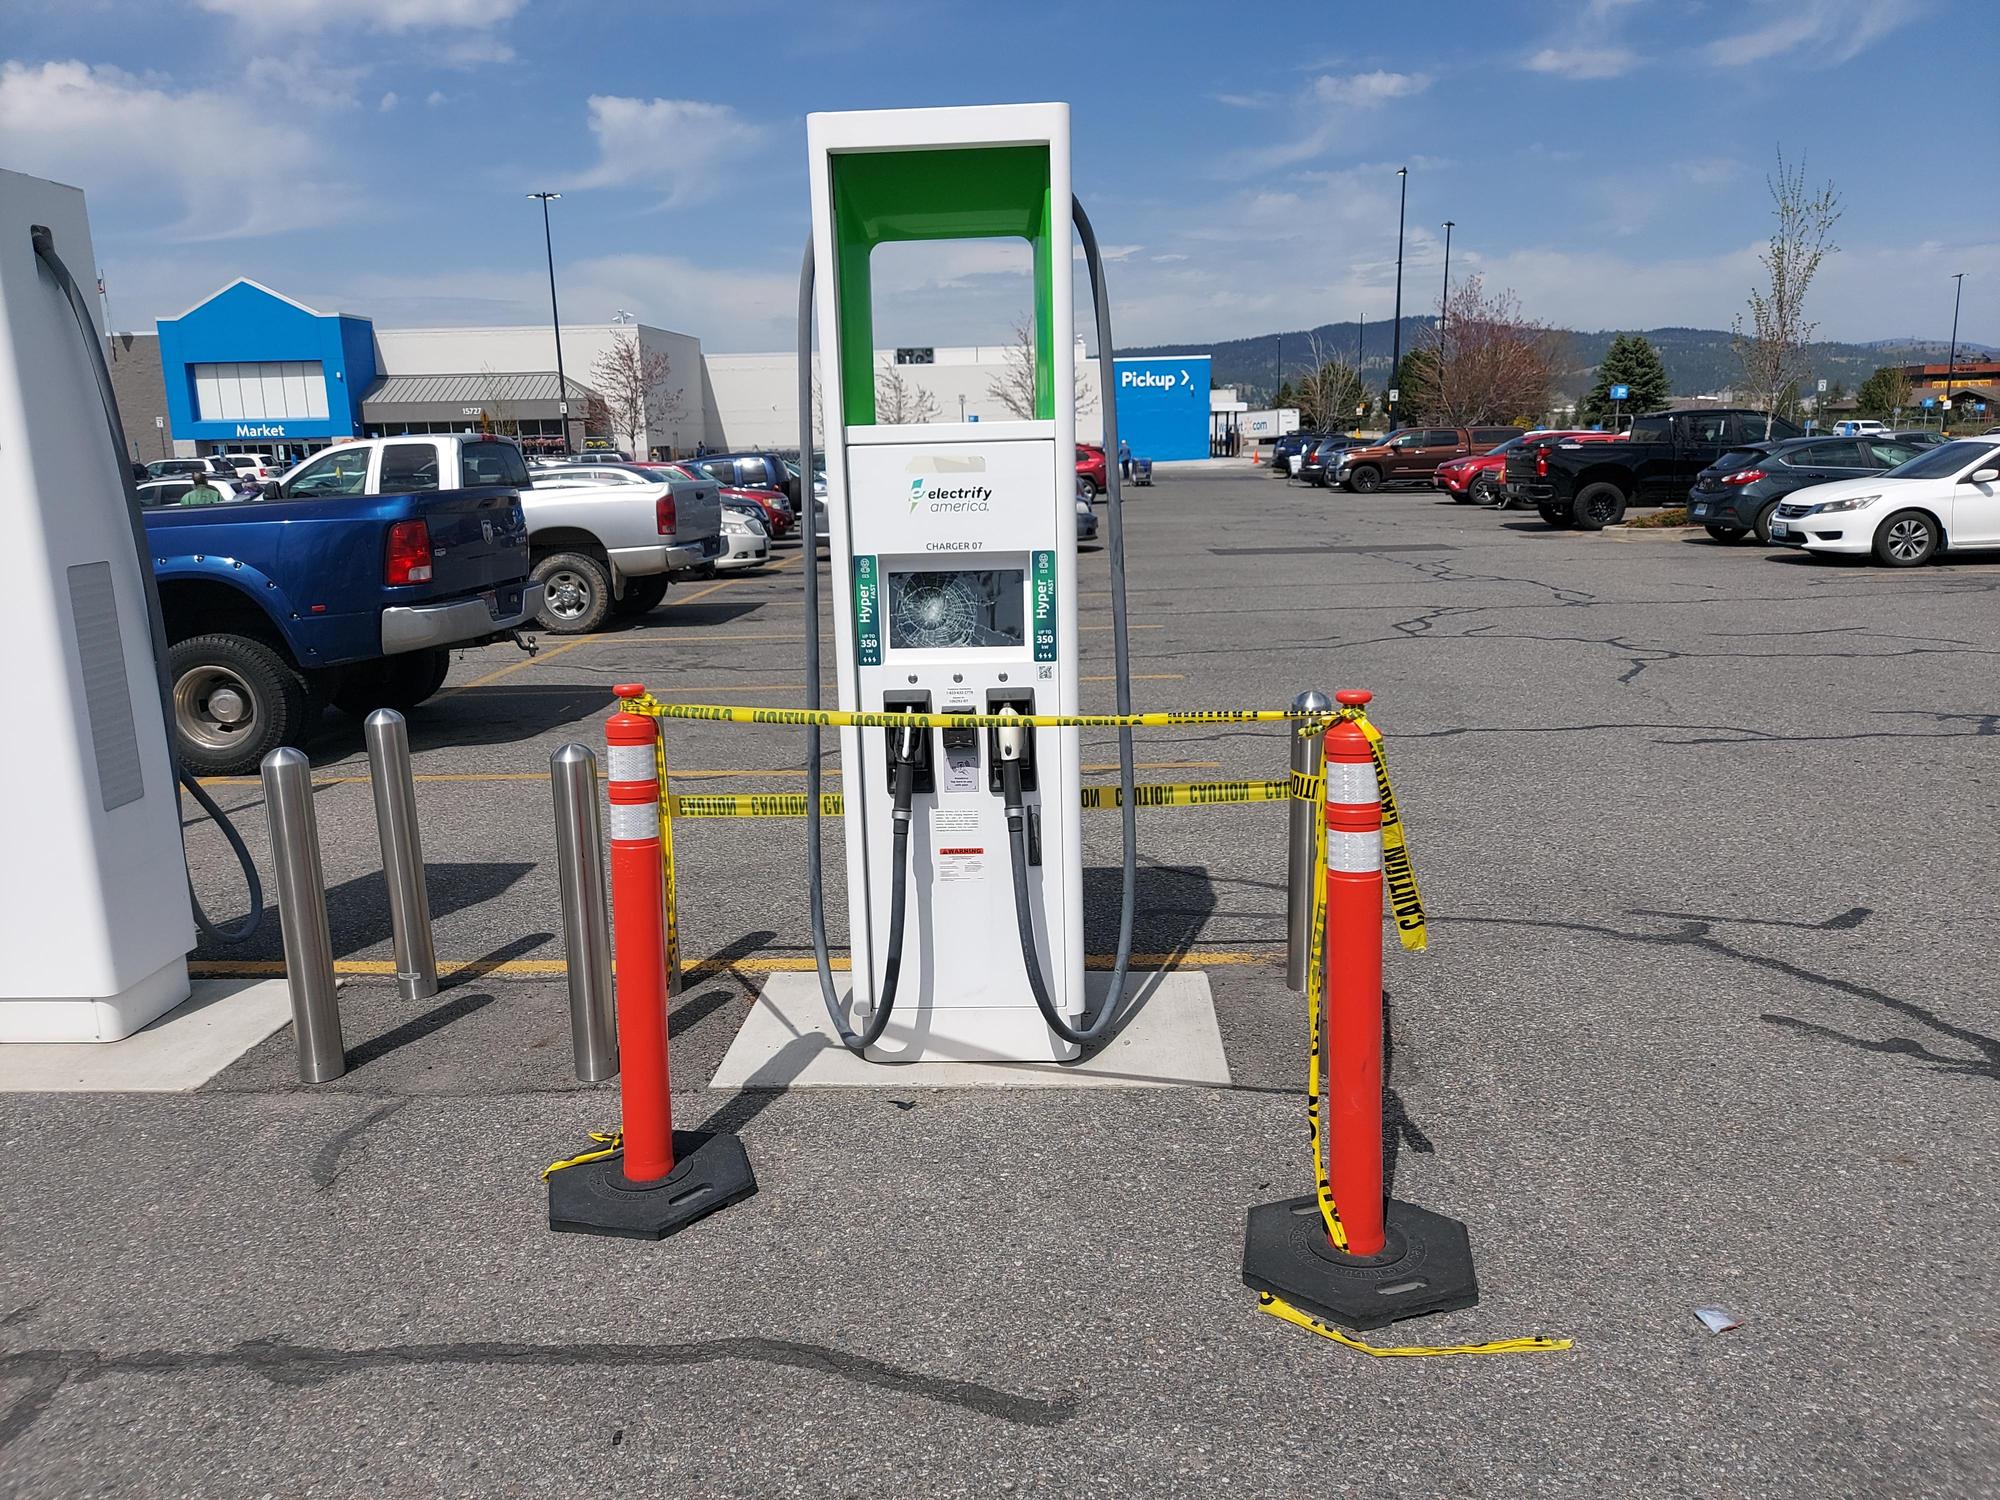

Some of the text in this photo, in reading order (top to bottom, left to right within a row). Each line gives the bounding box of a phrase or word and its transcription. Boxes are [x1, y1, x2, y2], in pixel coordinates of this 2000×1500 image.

[1121, 371, 1175, 390] Pickup
[462, 407, 482, 415] 15727
[236, 423, 286, 437] Market
[928, 486, 992, 501] electrify
[926, 541, 983, 551] CHARGER 07
[859, 583, 872, 623] Hyper
[1036, 579, 1049, 619] Hyper
[860, 639, 878, 648] 350
[1036, 635, 1054, 644] 350
